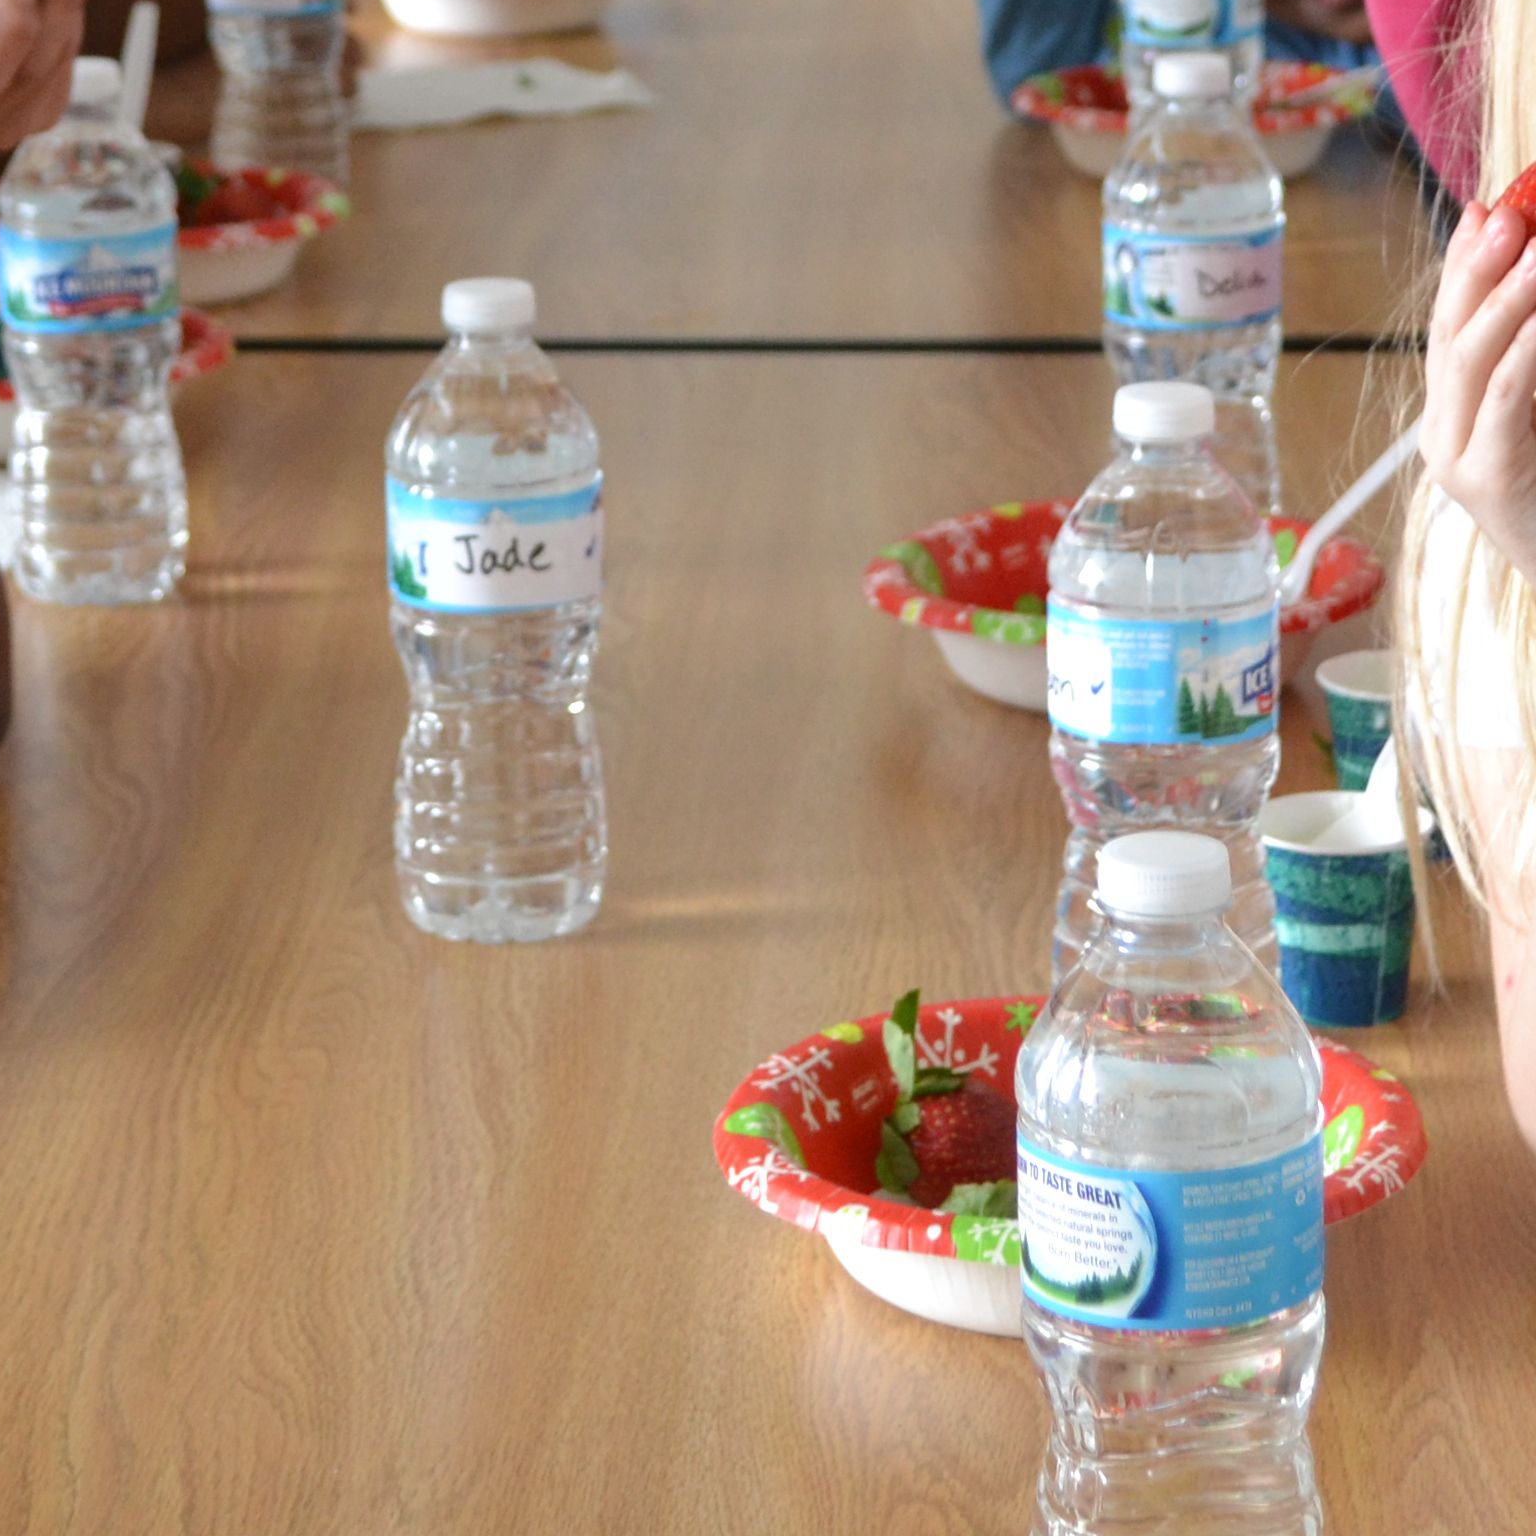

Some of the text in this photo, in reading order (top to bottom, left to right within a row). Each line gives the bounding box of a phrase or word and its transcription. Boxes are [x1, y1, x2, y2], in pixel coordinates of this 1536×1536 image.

[454, 534, 552, 575] Jade
[1042, 1168, 1073, 1196] TASTE
[1076, 1182, 1122, 1211] GREAT
